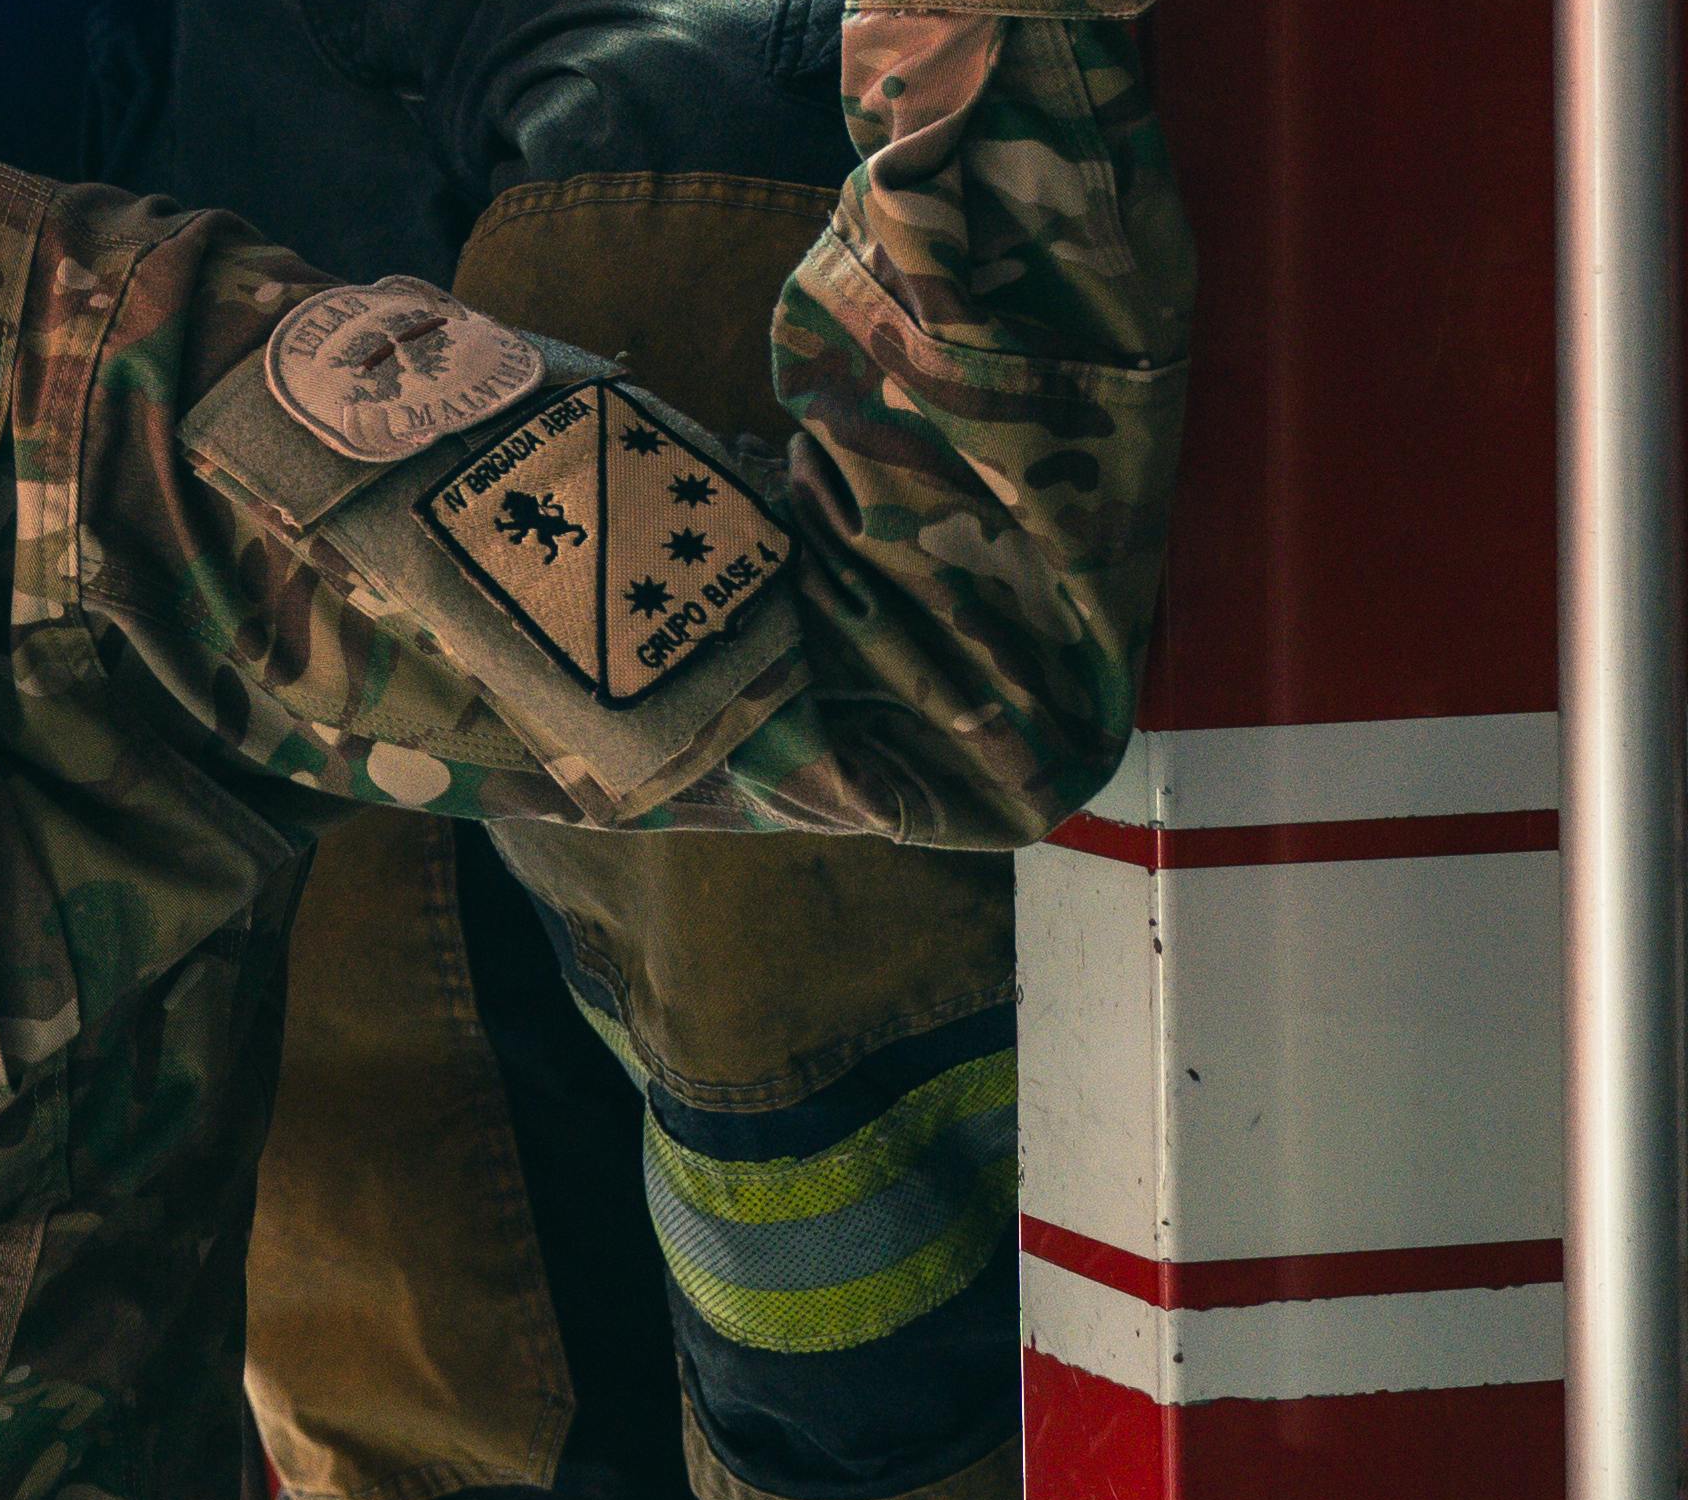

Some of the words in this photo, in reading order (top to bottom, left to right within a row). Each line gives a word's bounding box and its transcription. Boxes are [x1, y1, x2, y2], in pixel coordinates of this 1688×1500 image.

[443, 485, 468, 514] IV
[465, 430, 545, 495] BRIGADA
[637, 601, 707, 669] GRUPO
[701, 554, 764, 608] BASE
